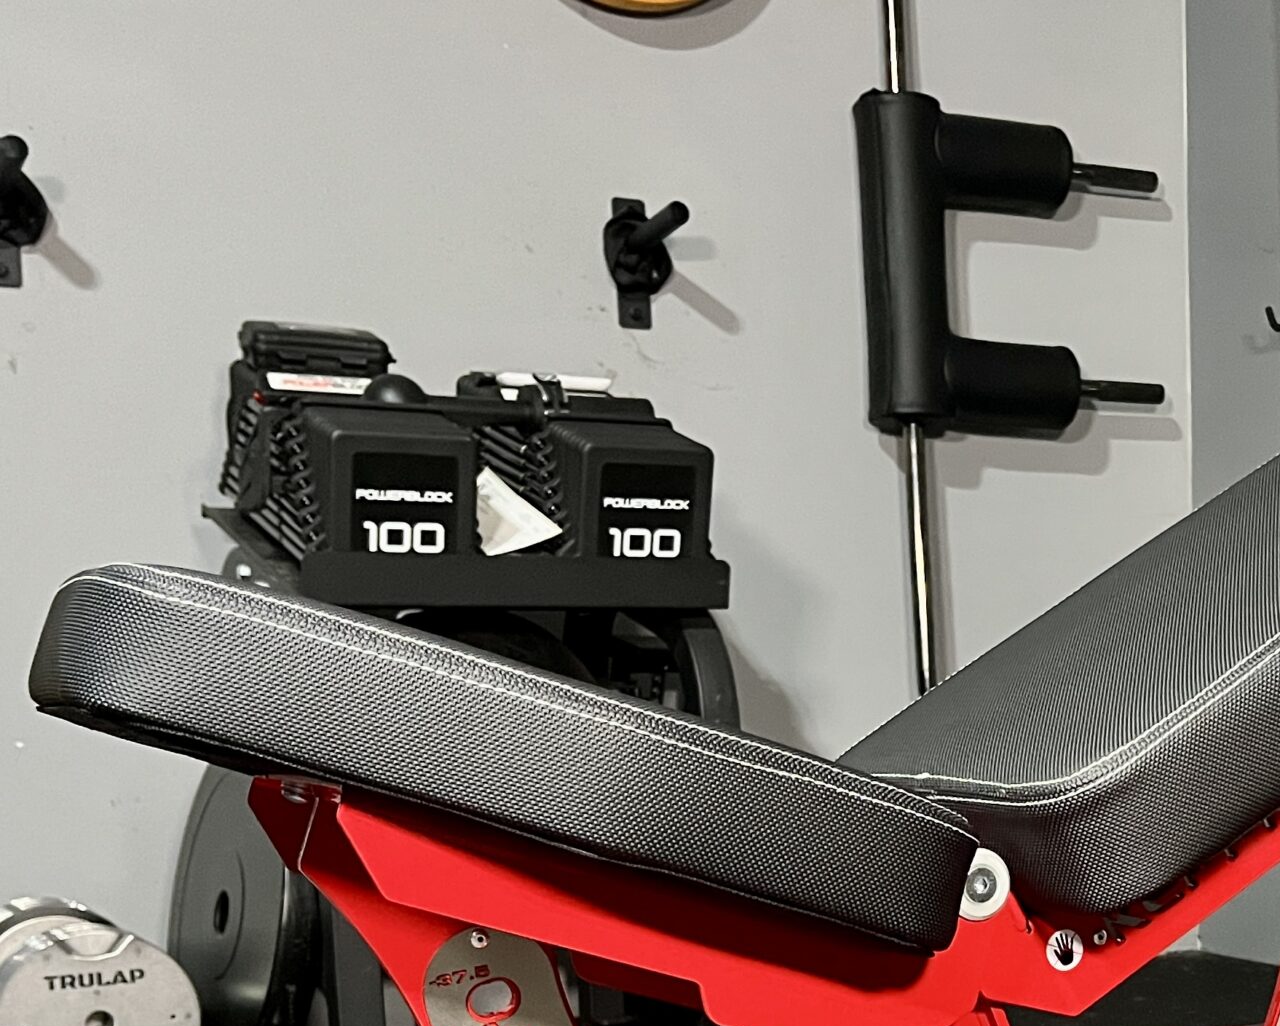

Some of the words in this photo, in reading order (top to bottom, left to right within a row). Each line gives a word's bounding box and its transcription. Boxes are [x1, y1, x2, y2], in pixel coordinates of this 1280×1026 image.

[355, 488, 453, 503] POWERBLOCK
[603, 497, 690, 510] POWERBLOCK
[363, 520, 445, 553] 100
[609, 527, 681, 558] 100
[43, 968, 146, 991] TRULAP
[429, 964, 491, 988] -37.5
